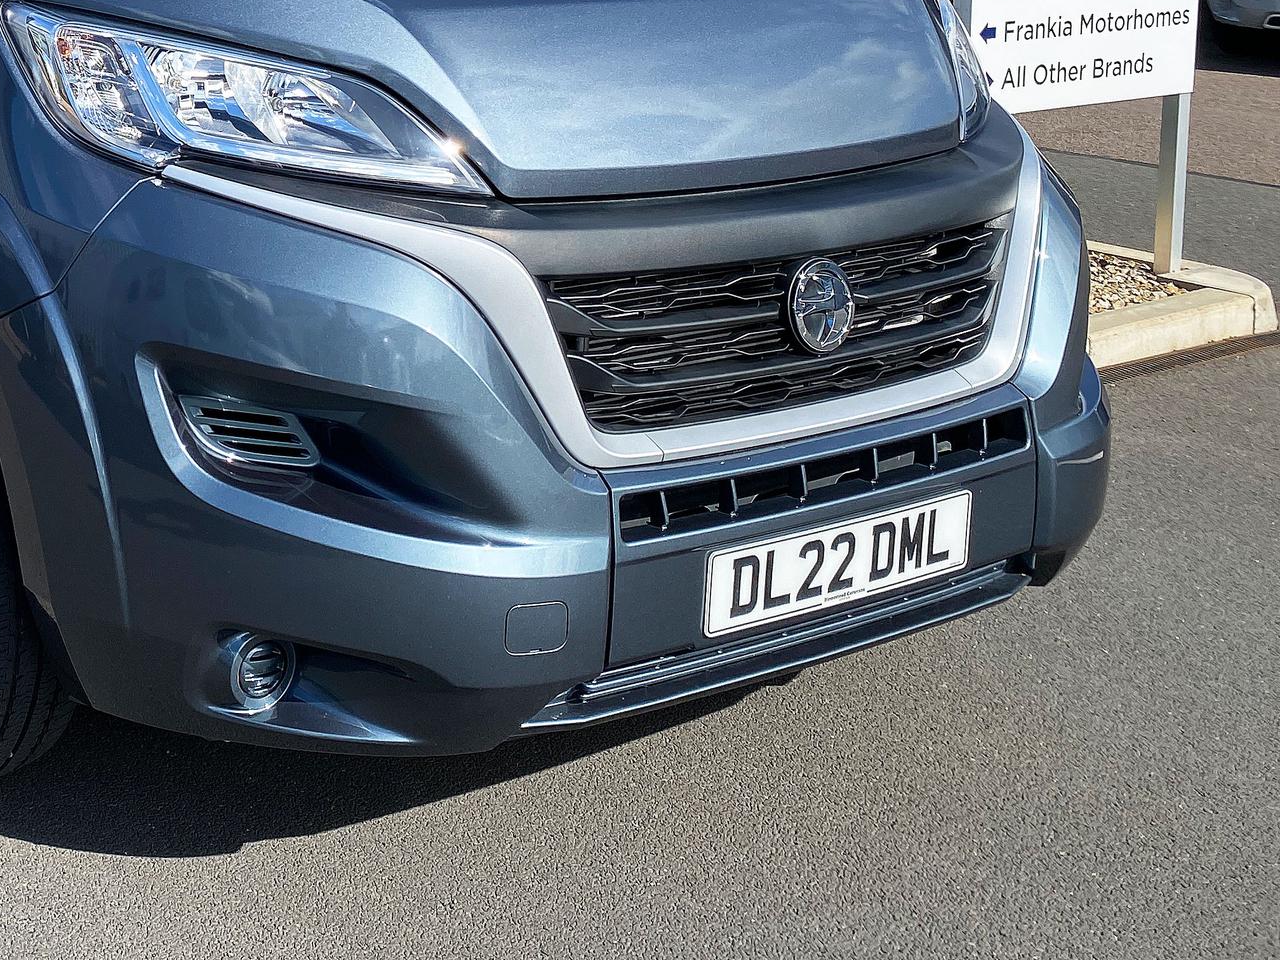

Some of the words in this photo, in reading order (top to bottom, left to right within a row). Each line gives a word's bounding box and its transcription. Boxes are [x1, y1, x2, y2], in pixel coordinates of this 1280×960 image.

[1004, 16, 1072, 42] Frankia
[1080, 9, 1190, 35] Motorhomes
[1001, 65, 1026, 90] All
[1033, 62, 1086, 86] Other
[1093, 53, 1153, 78] Brands
[730, 531, 856, 619] DL22
[869, 509, 950, 582] DML
